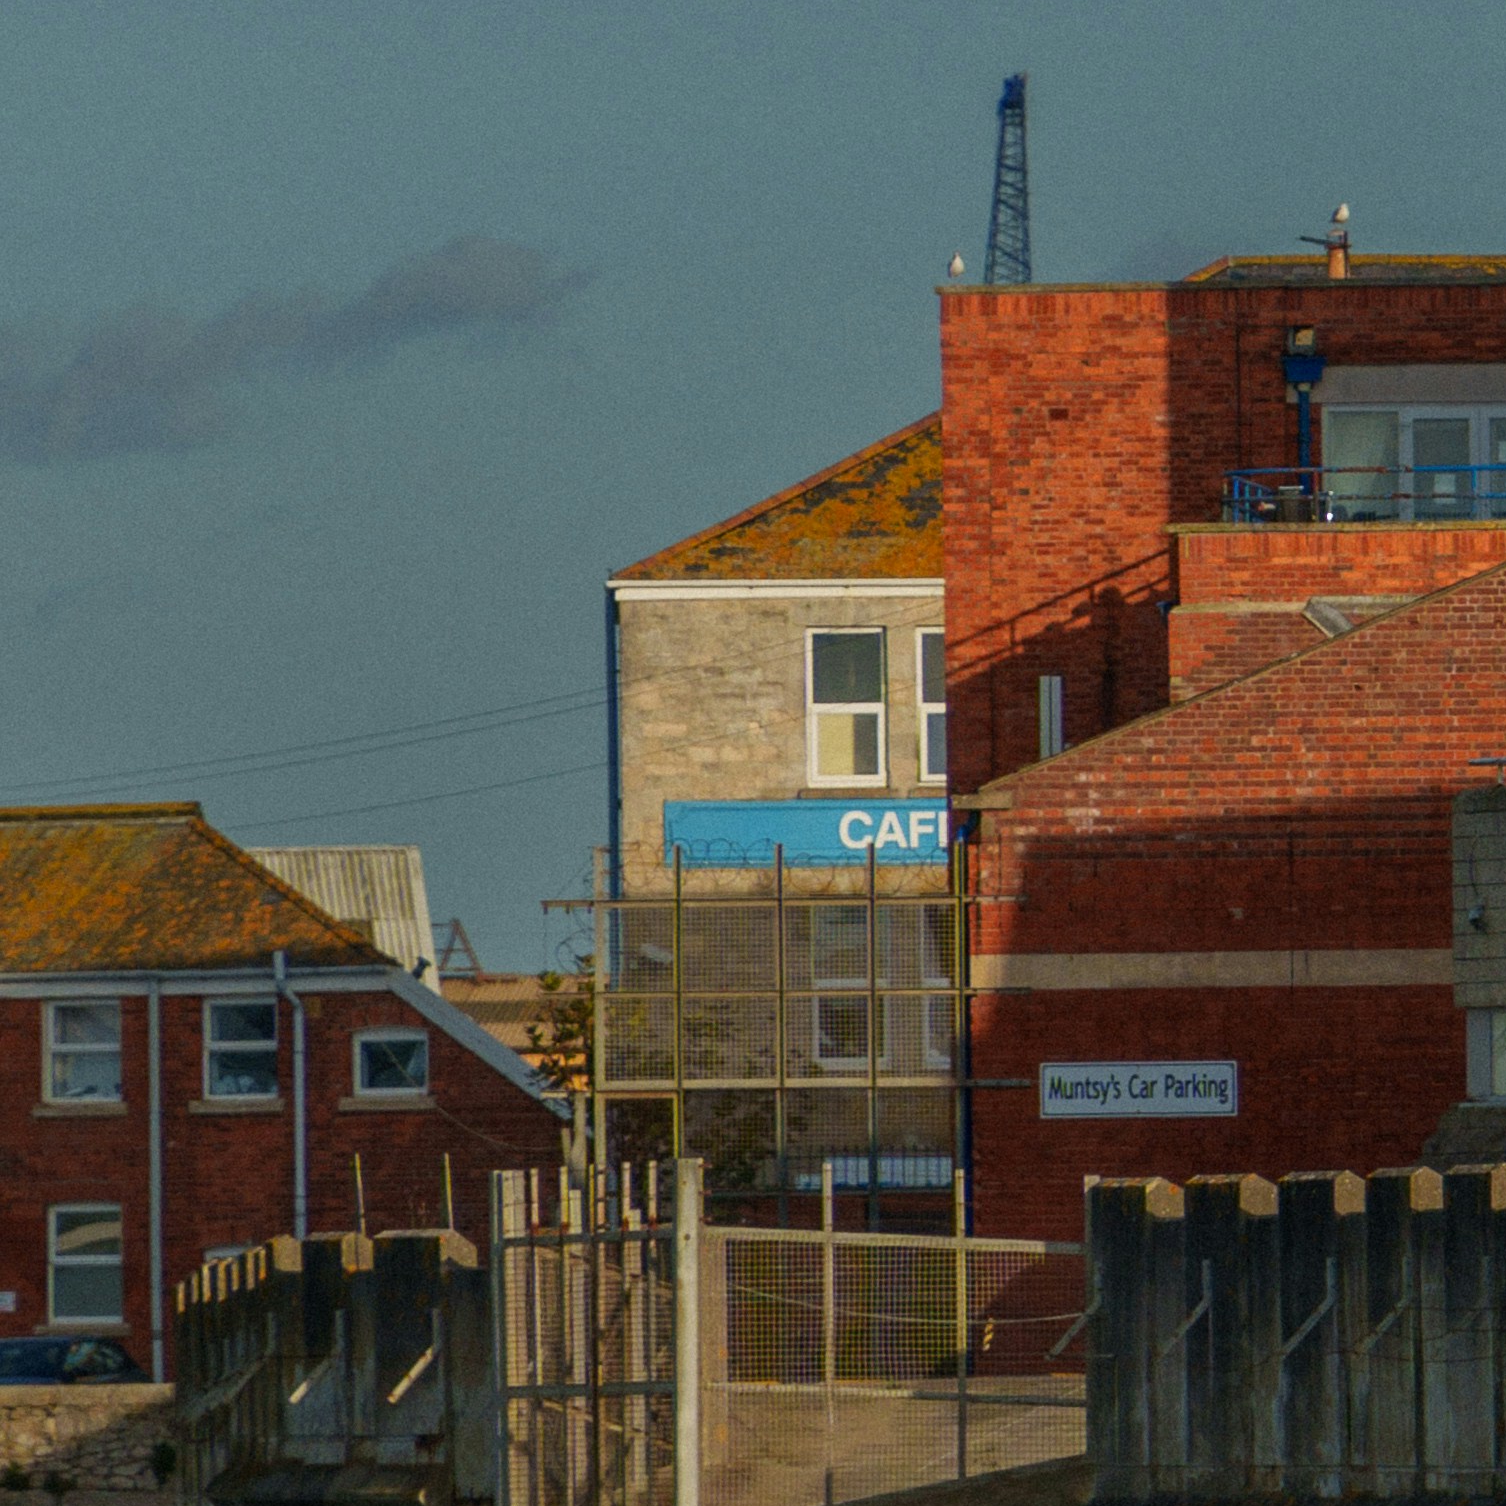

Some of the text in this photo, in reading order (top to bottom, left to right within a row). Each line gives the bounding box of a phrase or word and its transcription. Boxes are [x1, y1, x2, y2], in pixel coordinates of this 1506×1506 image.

[1049, 1073, 1229, 1104] Muntsy's Car Parking
